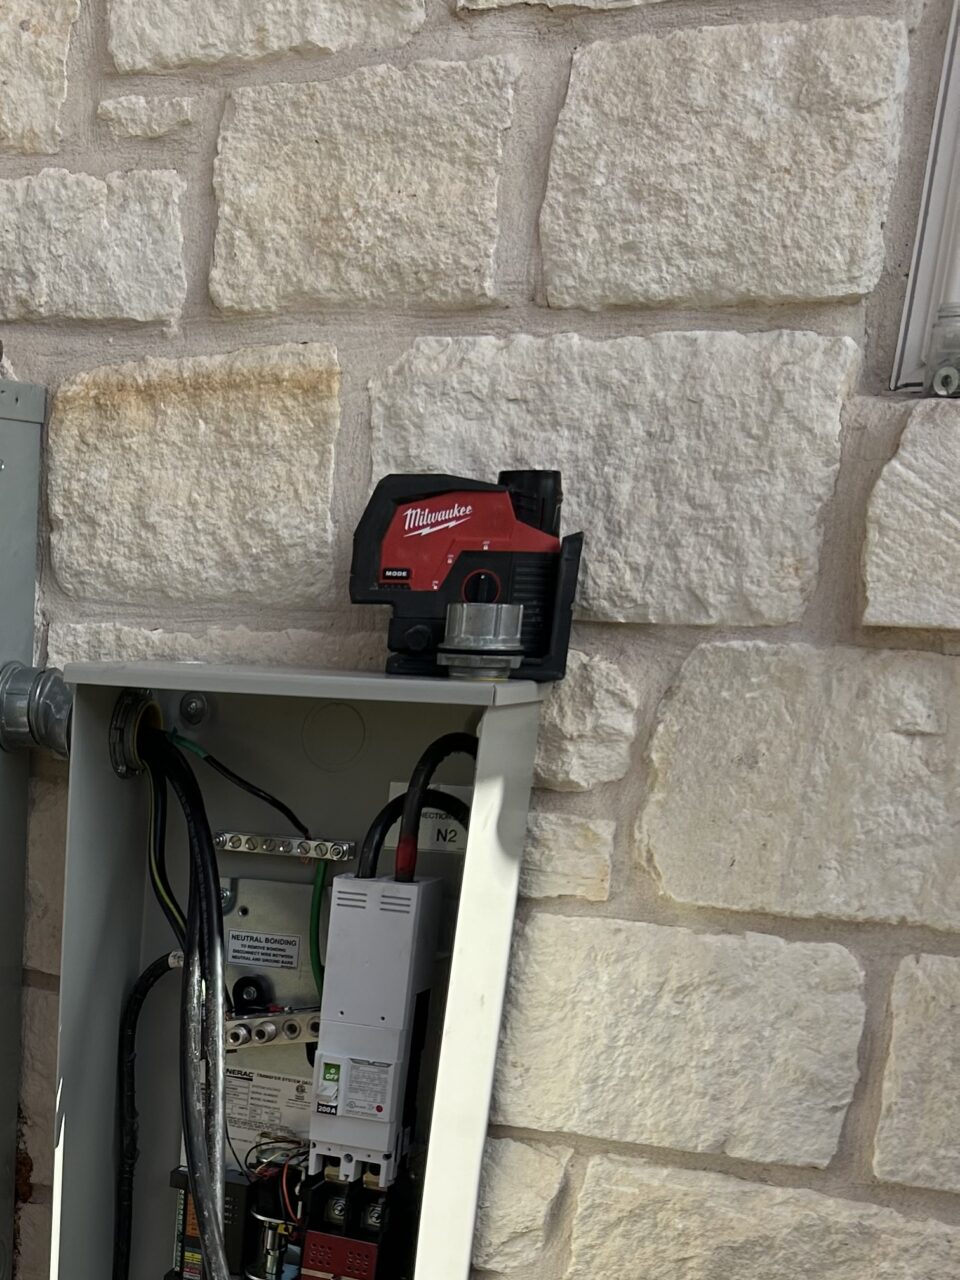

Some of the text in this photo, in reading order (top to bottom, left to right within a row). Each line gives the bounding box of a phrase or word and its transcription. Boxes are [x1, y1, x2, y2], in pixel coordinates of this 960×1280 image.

[403, 503, 473, 530] Milwaukee
[436, 828, 458, 843] N2
[231, 934, 297, 947] NEUTRAL BONDING
[225, 1068, 254, 1078] NERAC
